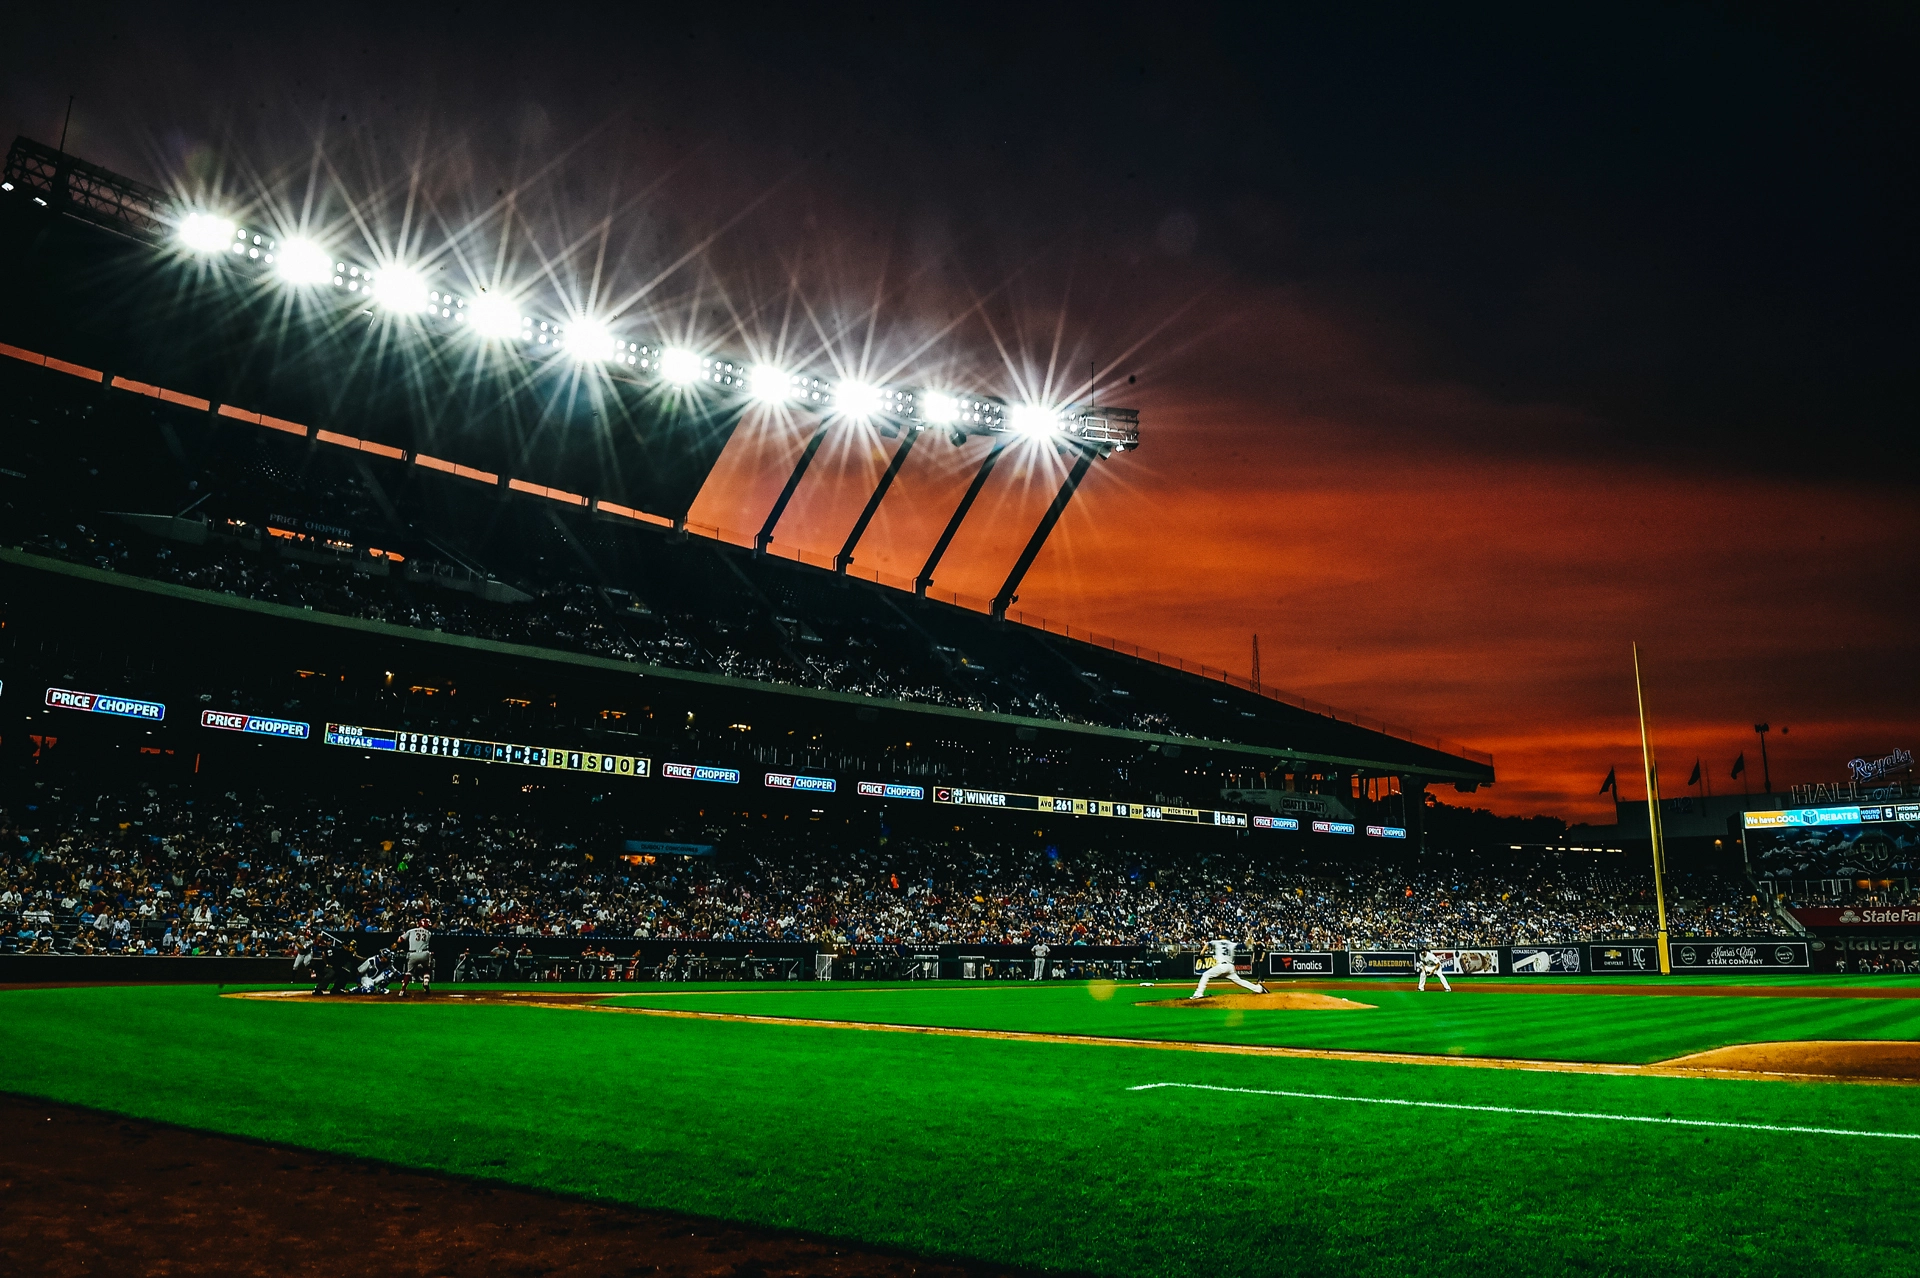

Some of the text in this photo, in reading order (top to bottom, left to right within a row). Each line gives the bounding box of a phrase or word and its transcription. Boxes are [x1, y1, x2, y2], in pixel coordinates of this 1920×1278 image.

[269, 513, 351, 538] PRICE CHOPPER
[51, 691, 159, 717] PRICE CHOPPER
[206, 713, 304, 736] PRICE CHOPPER
[338, 725, 363, 736] REDS
[337, 737, 373, 747] ROYALS
[496, 748, 503, 757] R
[533, 752, 539, 761] E
[553, 752, 564, 766] B
[572, 754, 579, 767] 1
[587, 756, 597, 769] S
[604, 757, 613, 771] 0
[636, 761, 646, 774] 2
[1847, 747, 1914, 783] Royals
[666, 765, 736, 781] PRICE CHOPPER
[768, 775, 833, 790] PRICE CHOPPER
[860, 784, 921, 798] PRICE CHOPPER
[1790, 781, 1868, 804] HALL
[1872, 781, 1898, 804] of
[966, 791, 1006, 806] WINKER
[1040, 800, 1052, 808] AVG
[1053, 800, 1072, 811] .261
[1075, 802, 1084, 810] HR
[1089, 802, 1096, 813] 3
[1116, 804, 1127, 816] 18
[1143, 806, 1161, 819] .366
[1182, 808, 1194, 816] TYPE
[1237, 817, 1245, 826] PM
[1885, 808, 1893, 818] 5
[1255, 817, 1297, 829] PRICE CHOPPER
[1745, 812, 1859, 825] We have COOL REBATES
[1314, 823, 1353, 833] PRICE CHOPPER
[1368, 827, 1405, 837] PRICE CHOPPER
[415, 932, 427, 942] 33
[1632, 948, 1646, 970] KC
[1736, 945, 1757, 960] City
[1292, 960, 1323, 971] Fanatics
